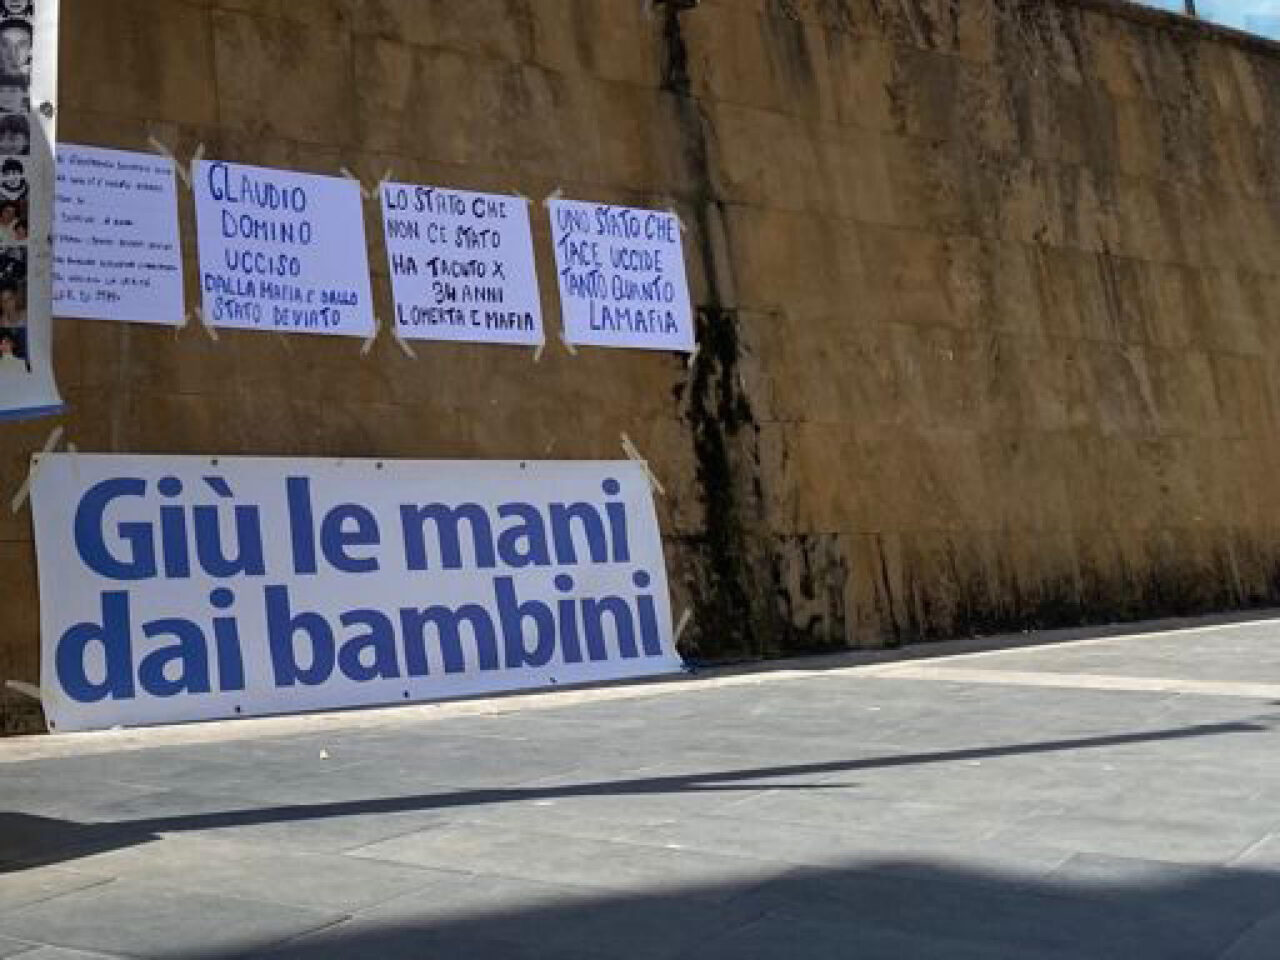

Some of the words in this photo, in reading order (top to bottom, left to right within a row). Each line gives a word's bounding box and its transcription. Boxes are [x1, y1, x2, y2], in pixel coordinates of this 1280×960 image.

[208, 164, 307, 212] CLAUDIO
[385, 188, 408, 210] LO
[414, 187, 466, 216] STATO
[472, 197, 507, 218] CHE
[222, 209, 311, 245] DOMINO
[387, 219, 420, 239] NON
[455, 224, 501, 249] STATO
[557, 208, 591, 233] UNO
[595, 206, 641, 238] STATO
[645, 214, 676, 243] CHE
[224, 249, 301, 277] UCCISO
[391, 254, 418, 276] HA
[492, 259, 506, 280] X
[559, 232, 602, 267] TACE
[609, 245, 663, 272] UCCIDE
[204, 272, 256, 298] DALLA
[462, 285, 503, 303] ANNI
[561, 267, 607, 301] TANTO
[612, 274, 675, 303] QUANTO
[213, 297, 262, 324] STATO
[485, 311, 535, 331] MAFIA
[74, 475, 266, 581] Giù
[285, 475, 381, 574] le
[399, 477, 631, 571] mani
[54, 586, 246, 704] dai
[264, 569, 663, 689] bambini
